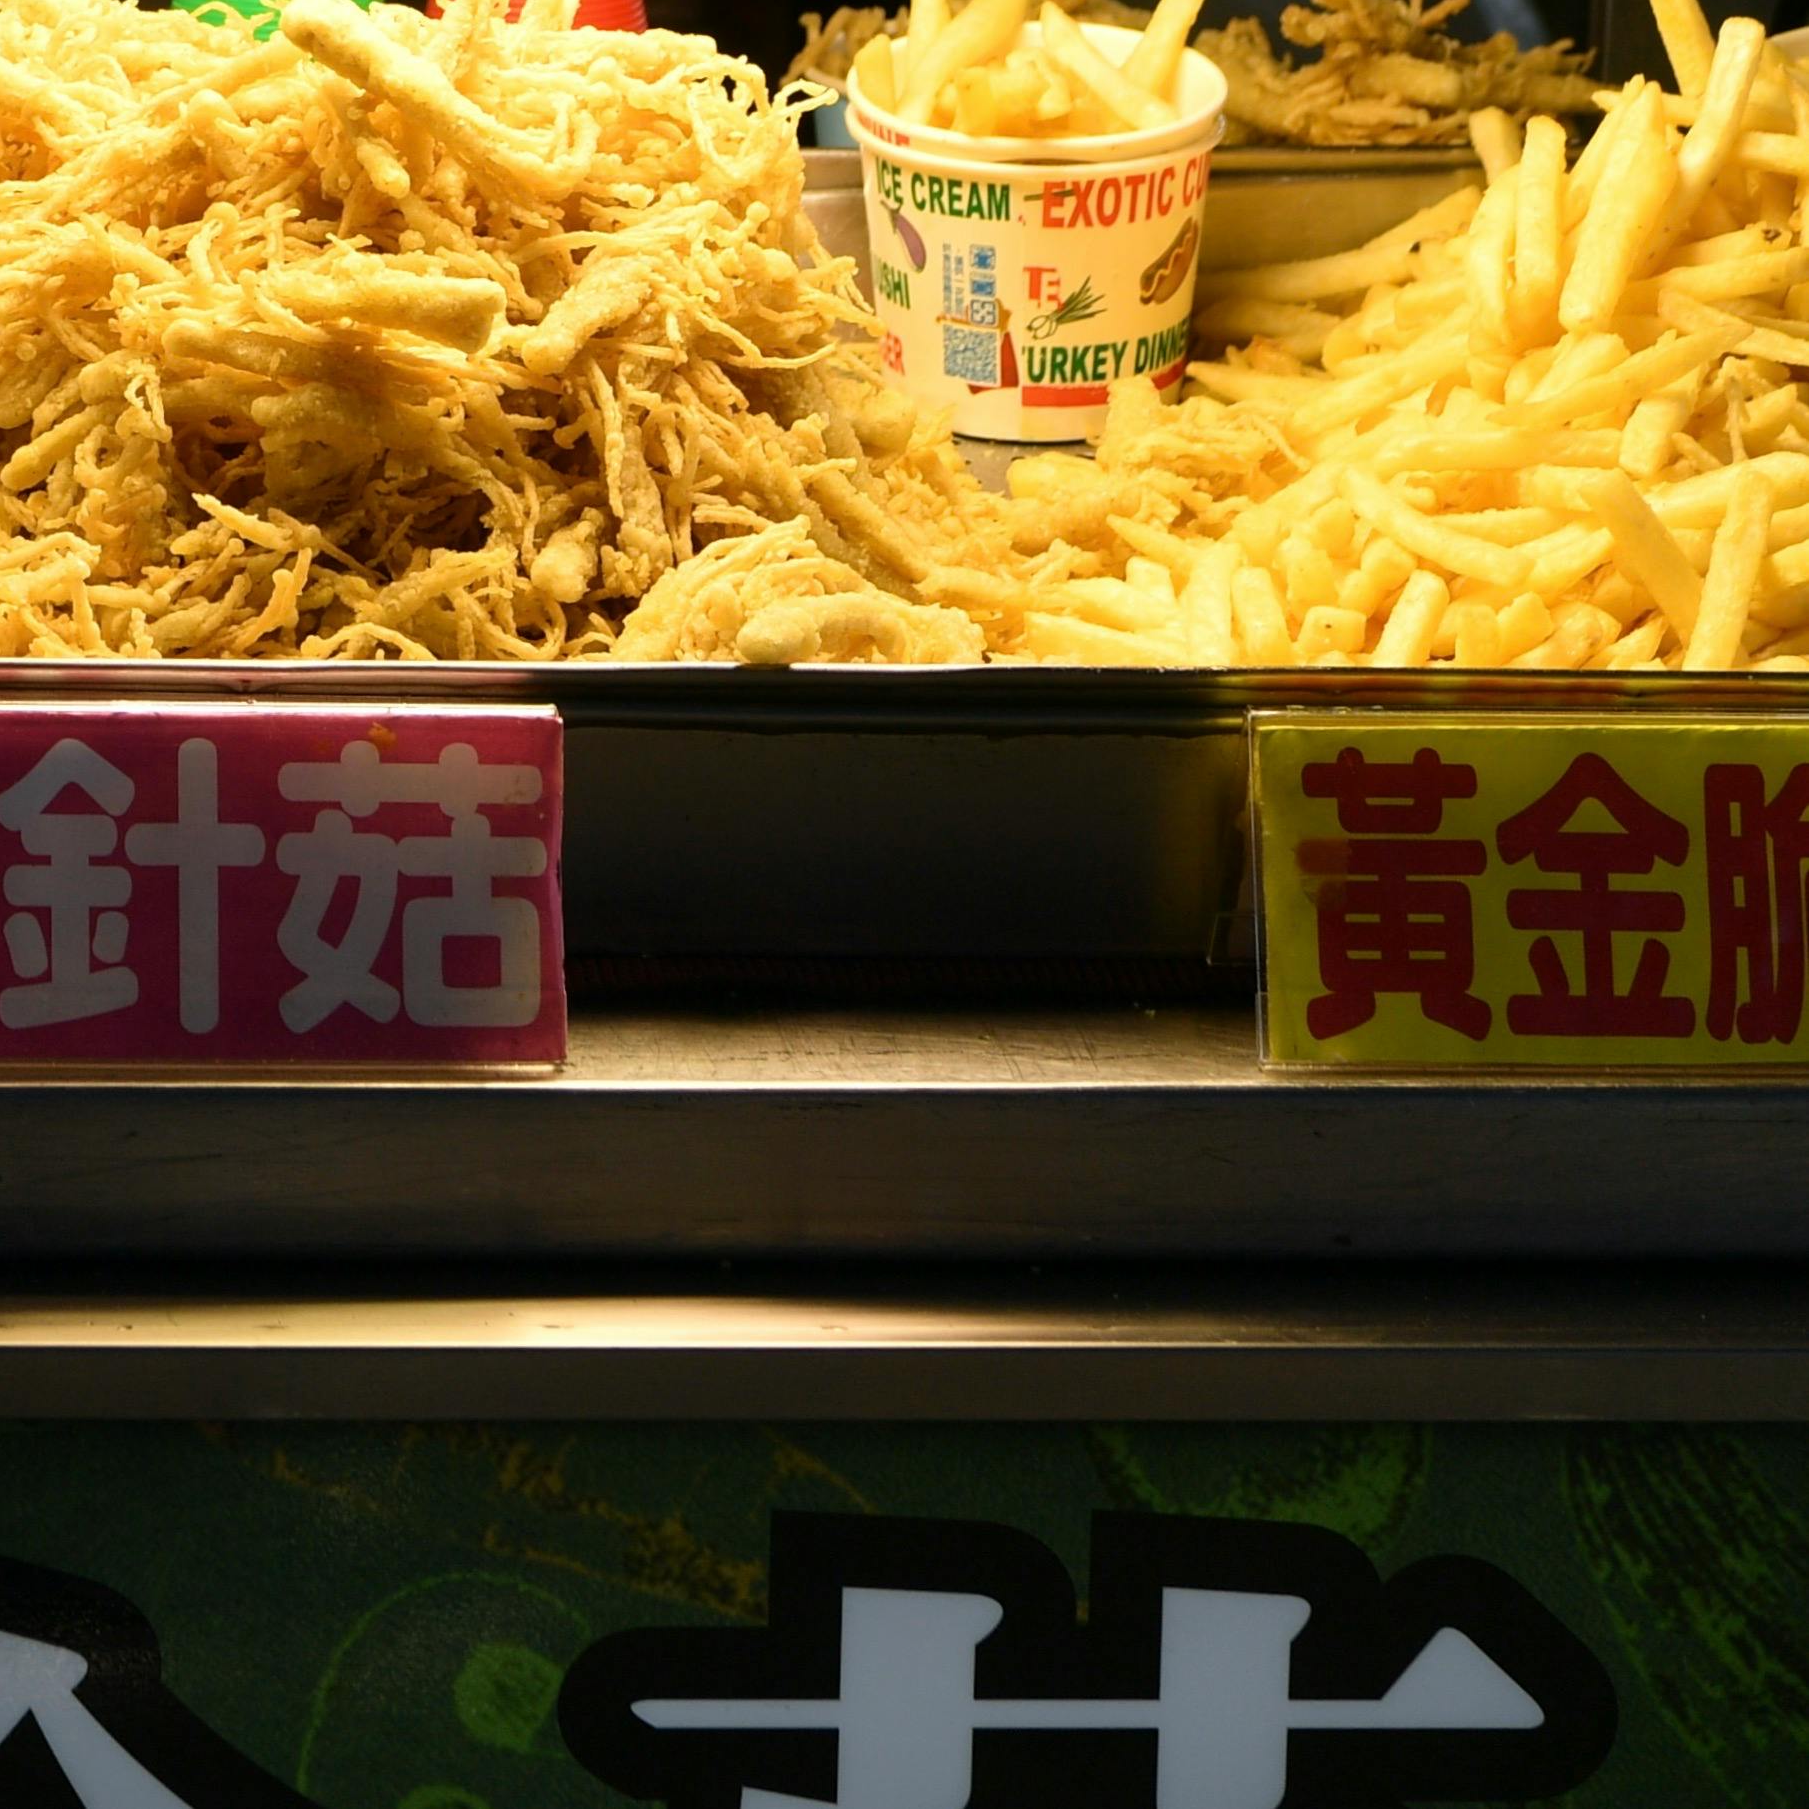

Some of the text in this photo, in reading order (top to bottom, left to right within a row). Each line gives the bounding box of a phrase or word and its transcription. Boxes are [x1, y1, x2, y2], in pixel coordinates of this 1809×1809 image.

[876, 155, 1011, 222] ICE CREAM
[1043, 166, 1175, 228] EXOTIC
[1022, 341, 1128, 383] URKEY
